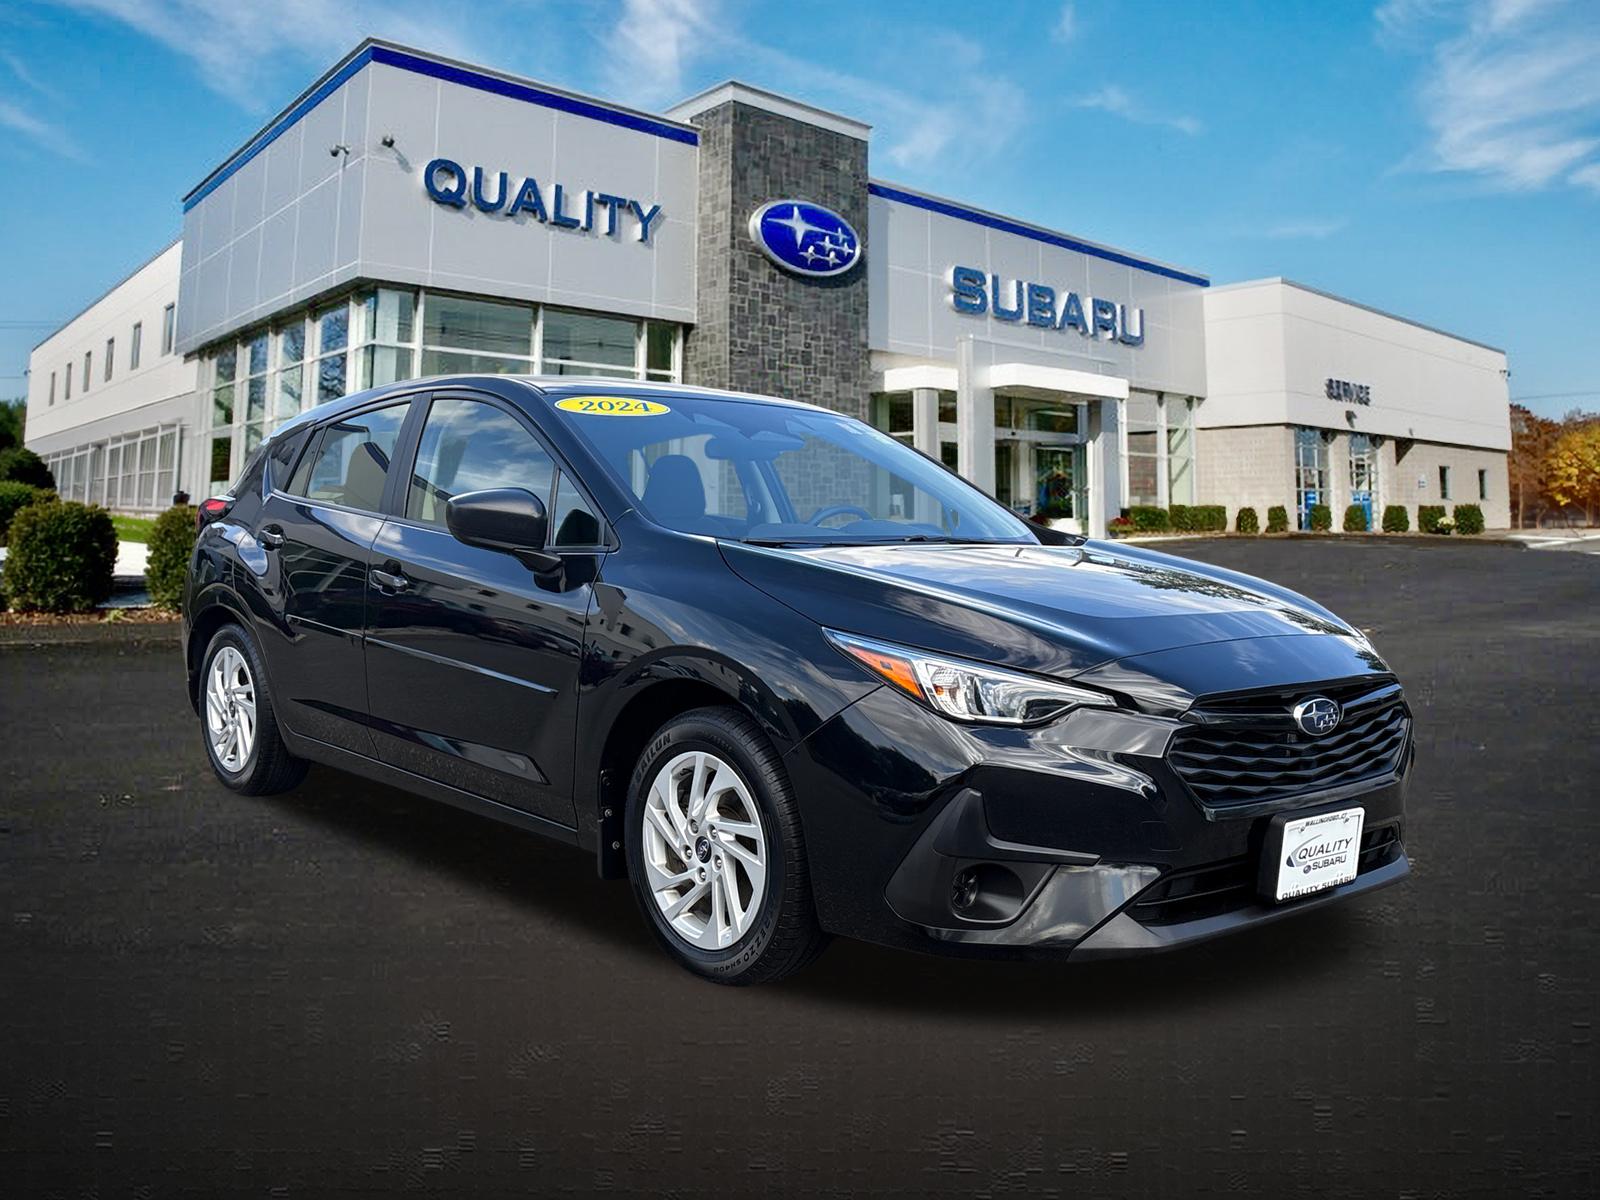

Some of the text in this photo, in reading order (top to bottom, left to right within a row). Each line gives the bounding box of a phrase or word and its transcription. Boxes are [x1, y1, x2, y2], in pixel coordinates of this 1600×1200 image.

[424, 158, 661, 243] QUALITY
[948, 265, 1145, 346] SUBARU
[1325, 378, 1371, 406] SERVICE
[579, 400, 653, 412] 2024
[1298, 837, 1353, 860] QUALITY
[1312, 854, 1347, 870] SUBARU
[1282, 874, 1355, 900] QUALITY SUBARU
